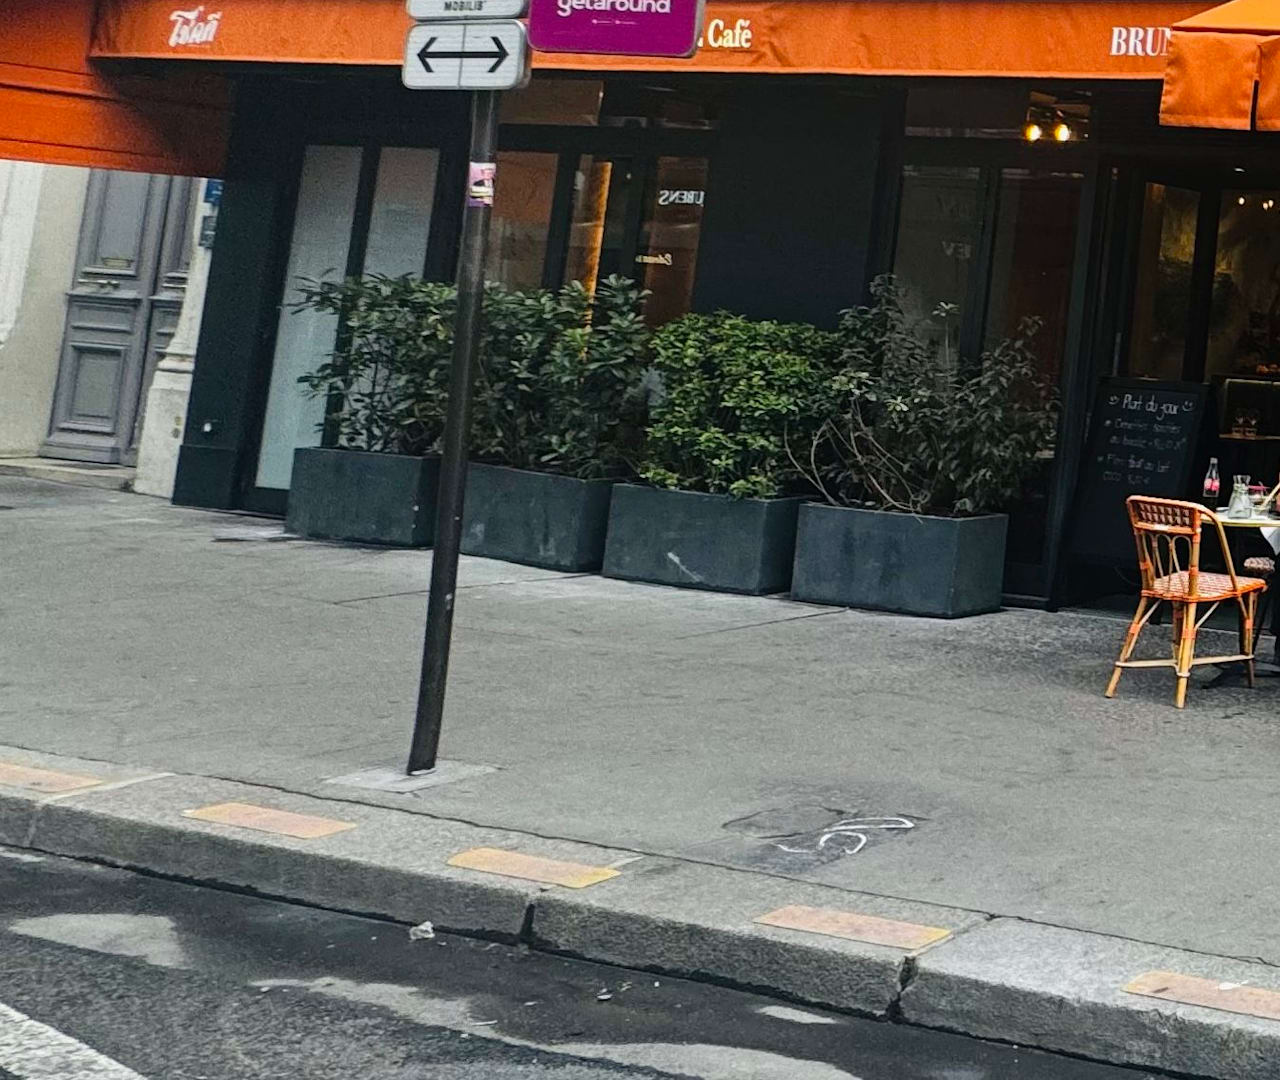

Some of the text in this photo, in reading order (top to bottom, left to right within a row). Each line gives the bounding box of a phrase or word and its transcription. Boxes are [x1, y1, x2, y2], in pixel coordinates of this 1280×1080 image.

[707, 18, 753, 48] Café
[1122, 393, 1143, 411] Plat
[1145, 394, 1159, 412] du
